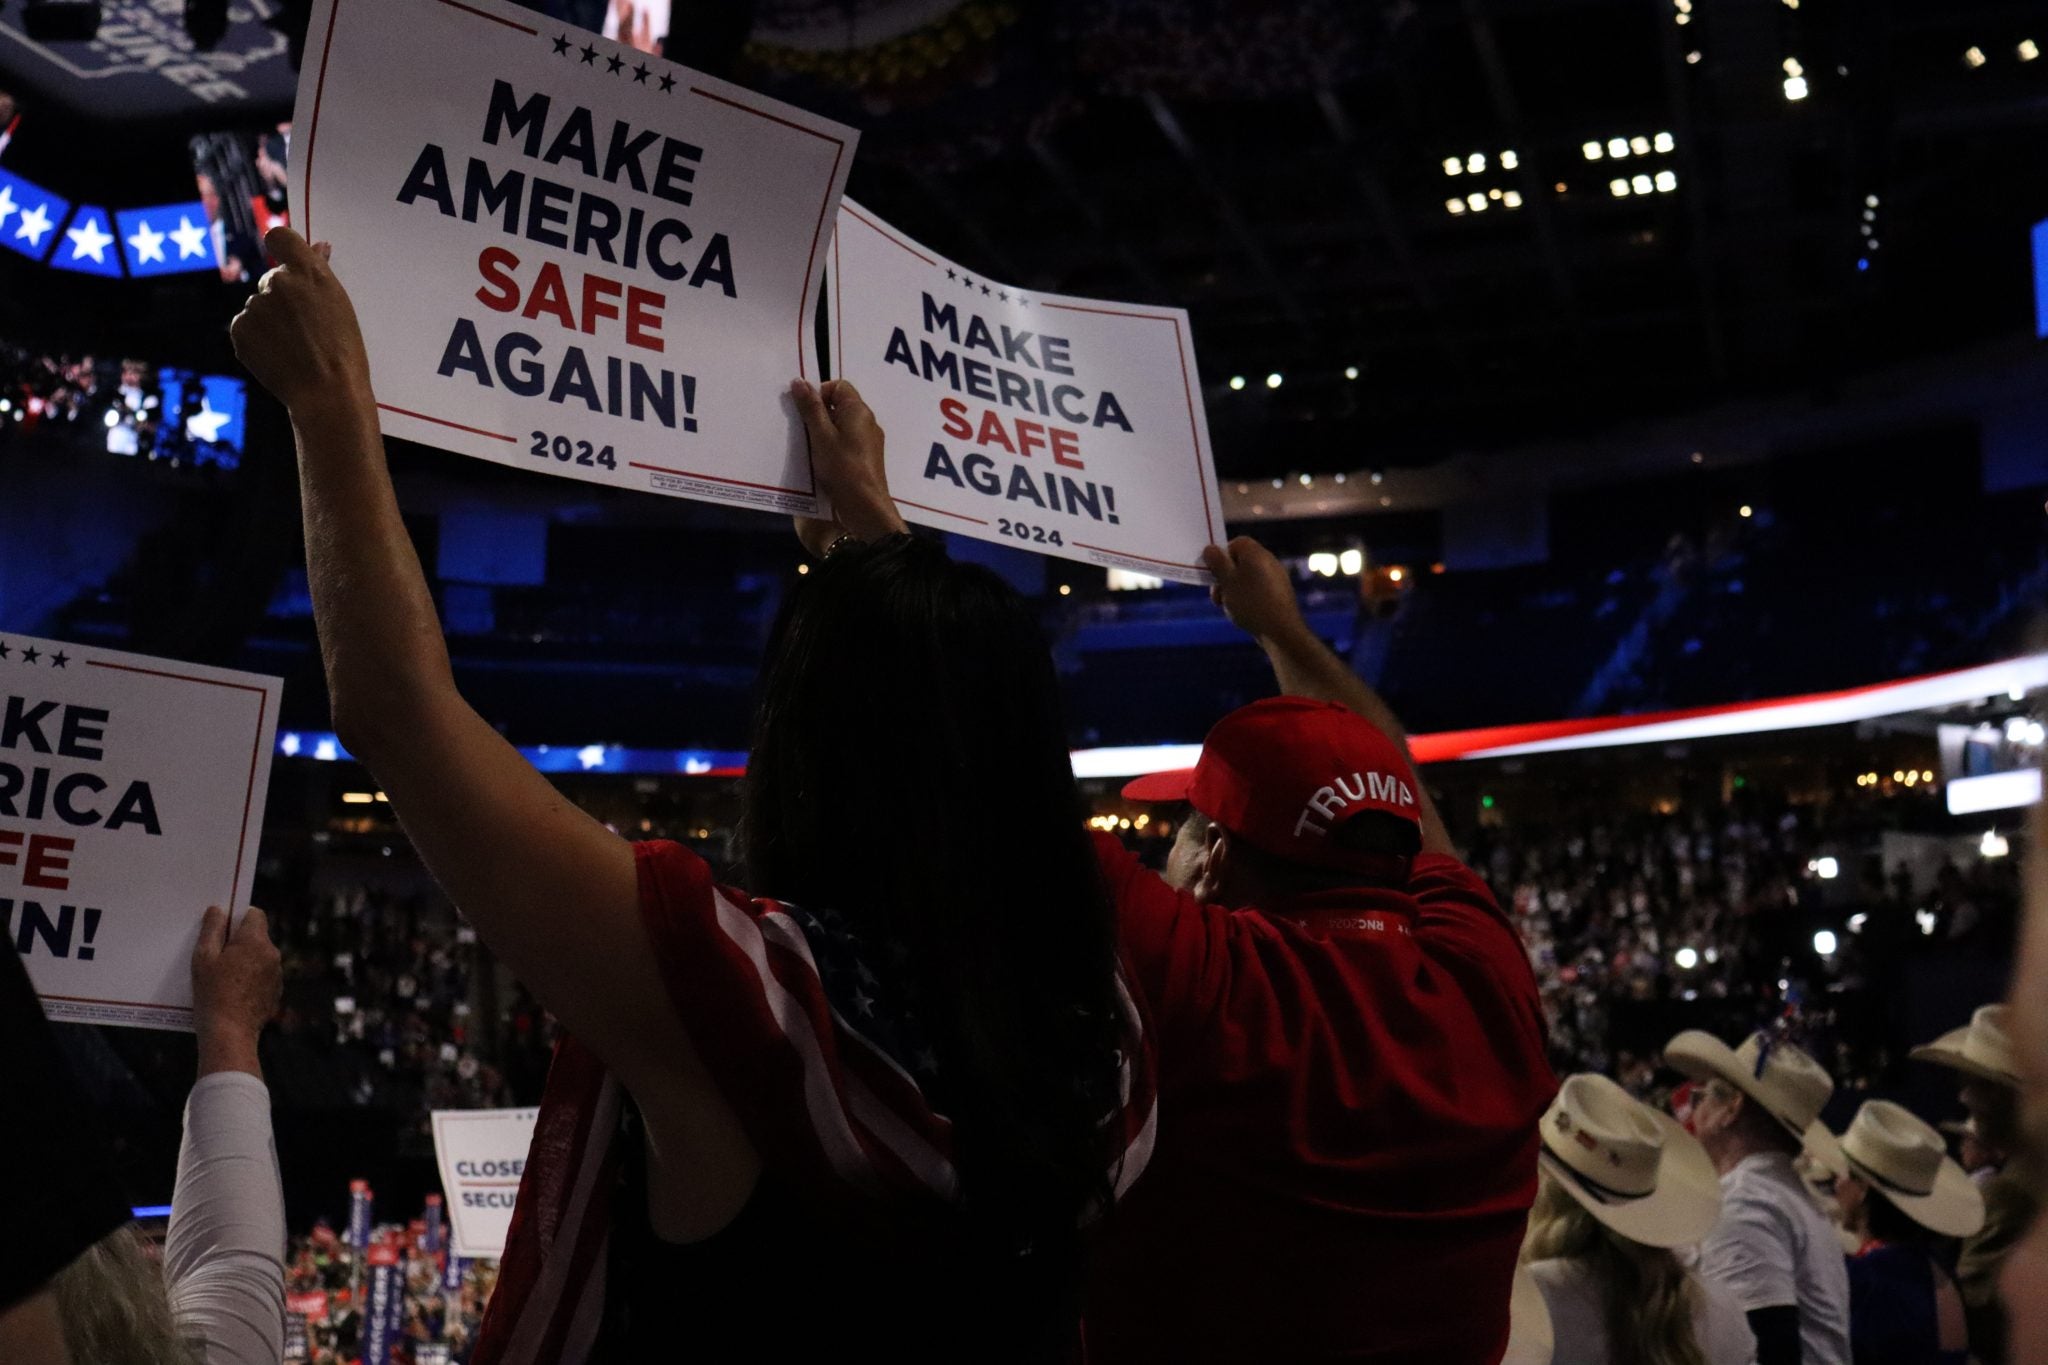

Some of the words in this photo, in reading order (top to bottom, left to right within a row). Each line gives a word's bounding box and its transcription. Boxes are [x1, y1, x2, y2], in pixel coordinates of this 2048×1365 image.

[482, 78, 703, 206] MAKE
[396, 143, 737, 299] AMERICA
[475, 246, 666, 353] SAFE
[922, 291, 1075, 376] MAKE
[437, 317, 697, 433] AGAIN!
[884, 326, 1134, 433] AMERICA
[530, 431, 617, 470] 2024
[939, 397, 1084, 470] SAFE
[923, 442, 1120, 525] AGAIN!
[998, 518, 1064, 547] 2024
[1, 696, 109, 760] KE
[1293, 771, 1415, 838] TRUMP
[456, 1161, 523, 1177] CLOSE
